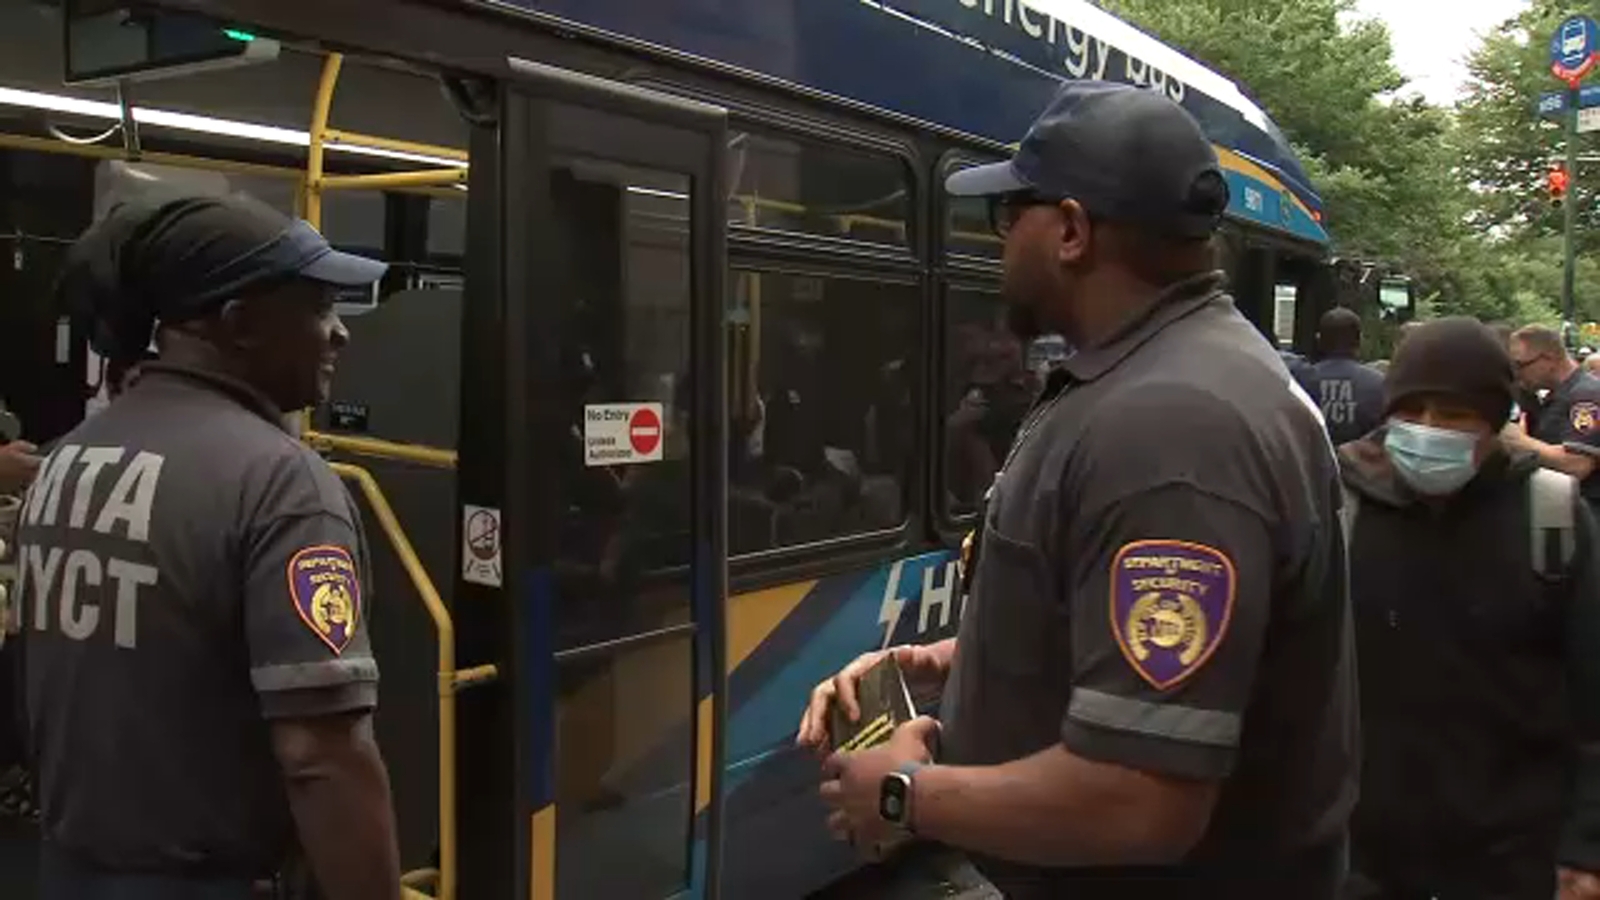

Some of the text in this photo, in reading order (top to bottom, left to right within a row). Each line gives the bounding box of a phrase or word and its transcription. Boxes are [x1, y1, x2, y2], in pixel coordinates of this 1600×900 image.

[587, 409, 629, 423] No Entry
[19, 444, 165, 542] MTA
